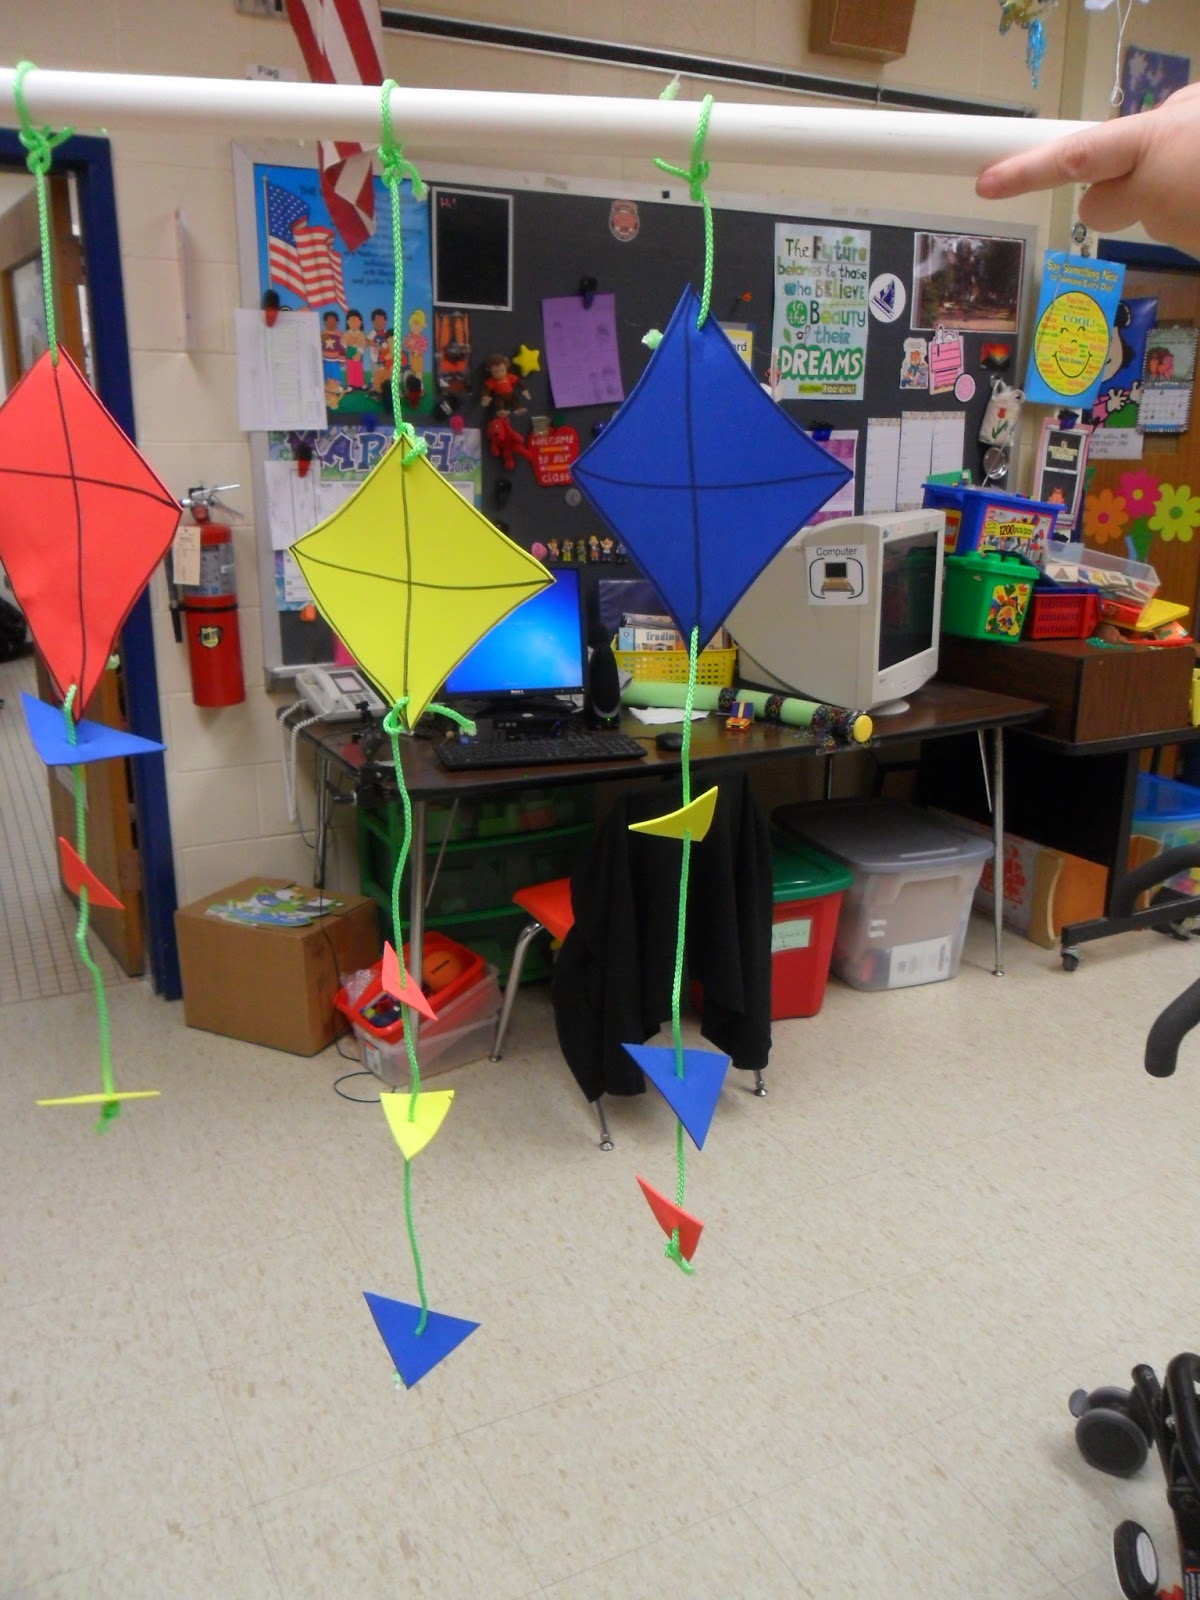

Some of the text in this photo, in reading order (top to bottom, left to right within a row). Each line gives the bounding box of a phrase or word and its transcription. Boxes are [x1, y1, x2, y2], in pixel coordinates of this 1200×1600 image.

[257, 64, 280, 79] Flag
[785, 235, 867, 263] The Future
[777, 256, 867, 280] belongs to those
[1047, 260, 1060, 272] Say
[1102, 269, 1119, 282] Nice
[784, 283, 812, 297] who
[792, 300, 804, 311] in
[788, 313, 806, 324] the
[796, 325, 811, 348] of
[781, 349, 862, 376] DREAMS
[284, 430, 452, 473] MARH
[538, 454, 571, 465] to our
[541, 472, 570, 483] class
[1000, 524, 1014, 536] 1200
[816, 547, 857, 557] Computer
[646, 631, 680, 642] Trading
